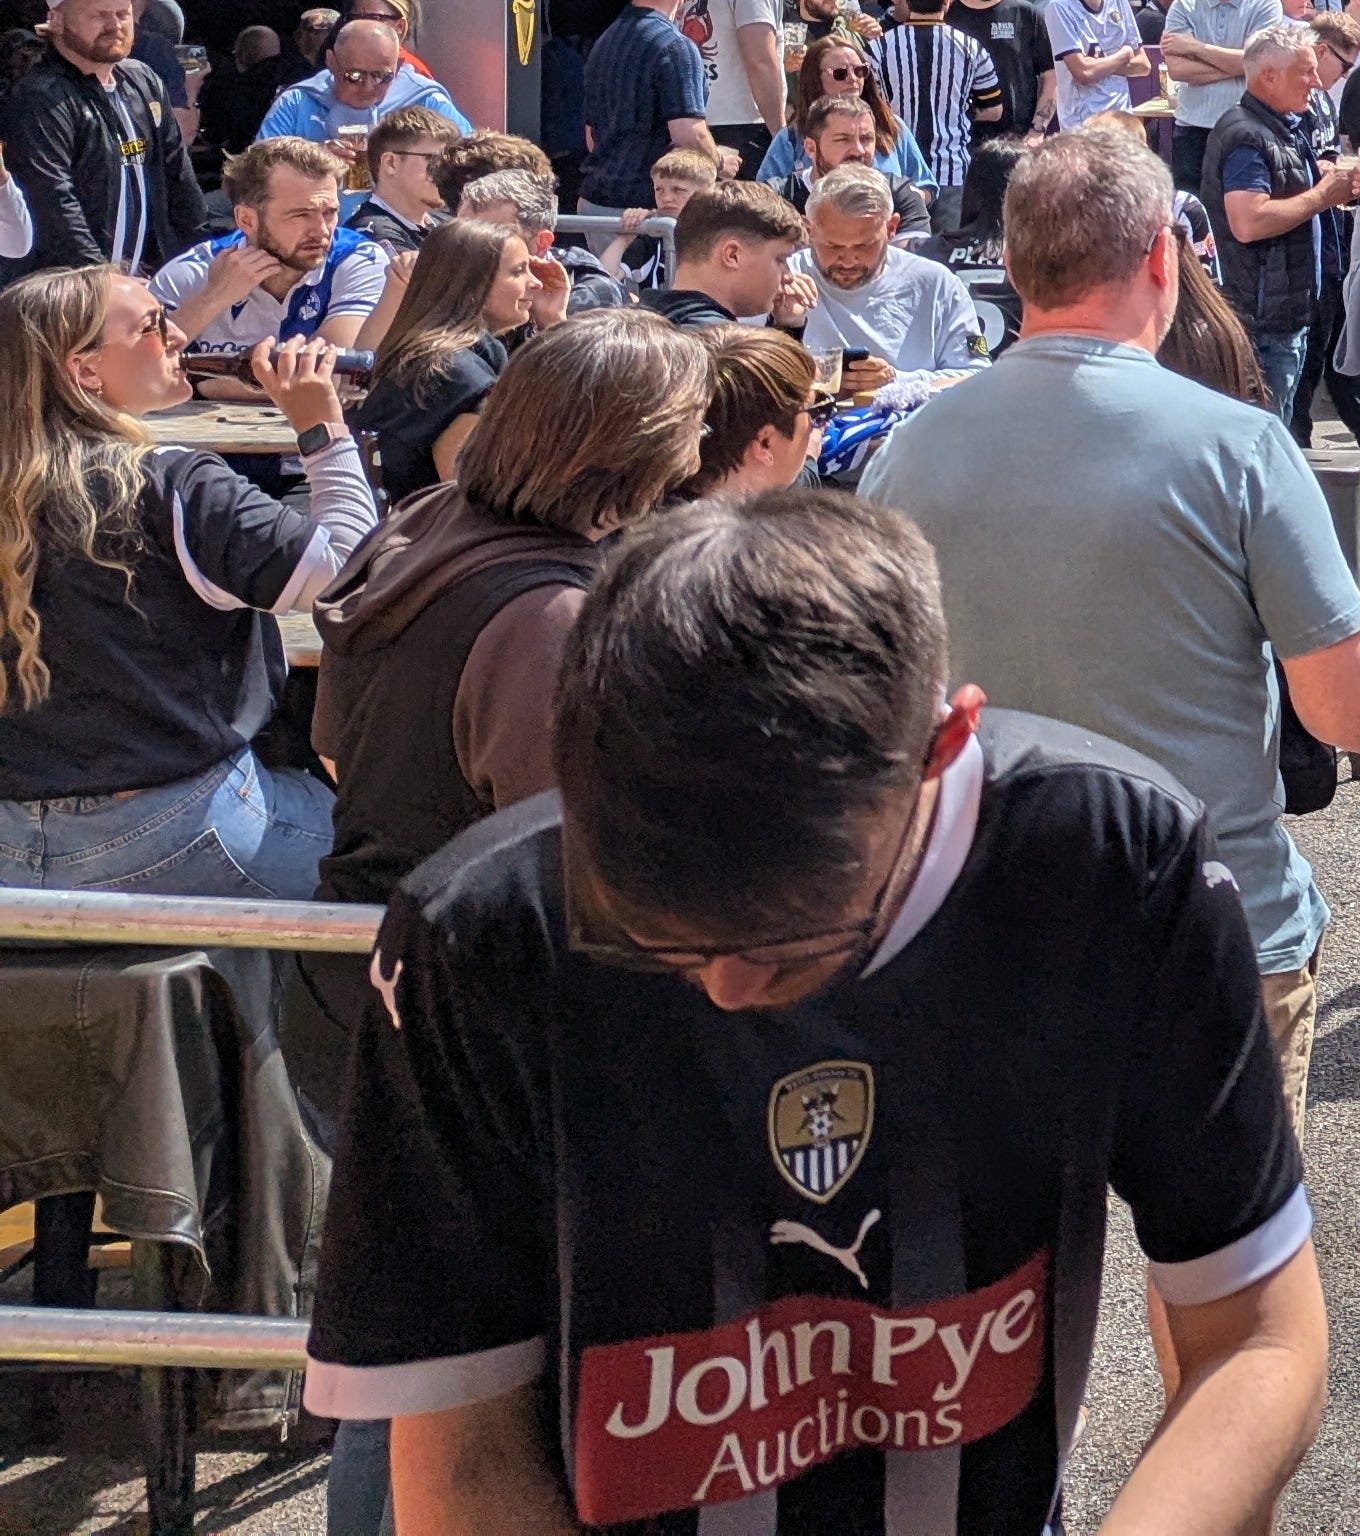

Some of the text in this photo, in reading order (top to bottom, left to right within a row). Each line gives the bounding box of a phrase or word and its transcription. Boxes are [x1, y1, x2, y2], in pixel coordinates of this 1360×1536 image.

[604, 1288, 1037, 1440] John Pye
[692, 1389, 963, 1502] Auctions
